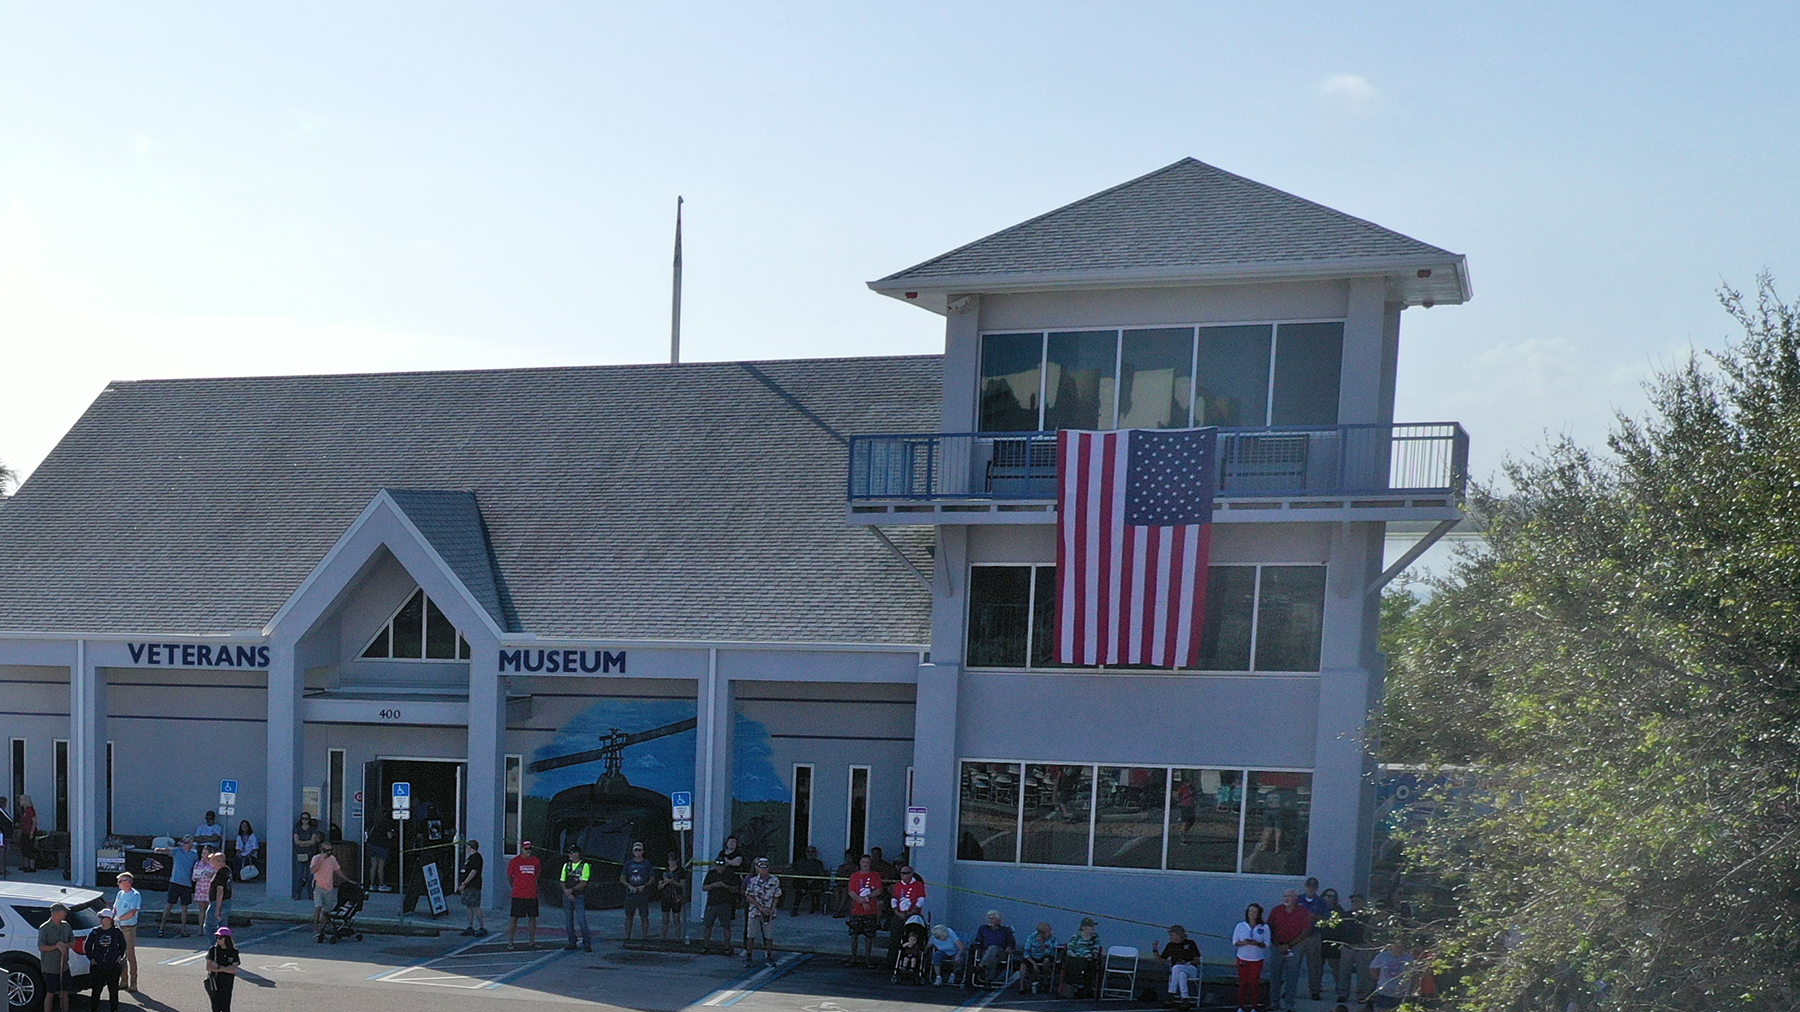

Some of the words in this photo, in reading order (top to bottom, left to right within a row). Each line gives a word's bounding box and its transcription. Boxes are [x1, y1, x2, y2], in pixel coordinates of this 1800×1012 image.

[127, 642, 270, 668] VETERANS
[499, 648, 627, 674] MUSEUM
[378, 708, 401, 720] 400
